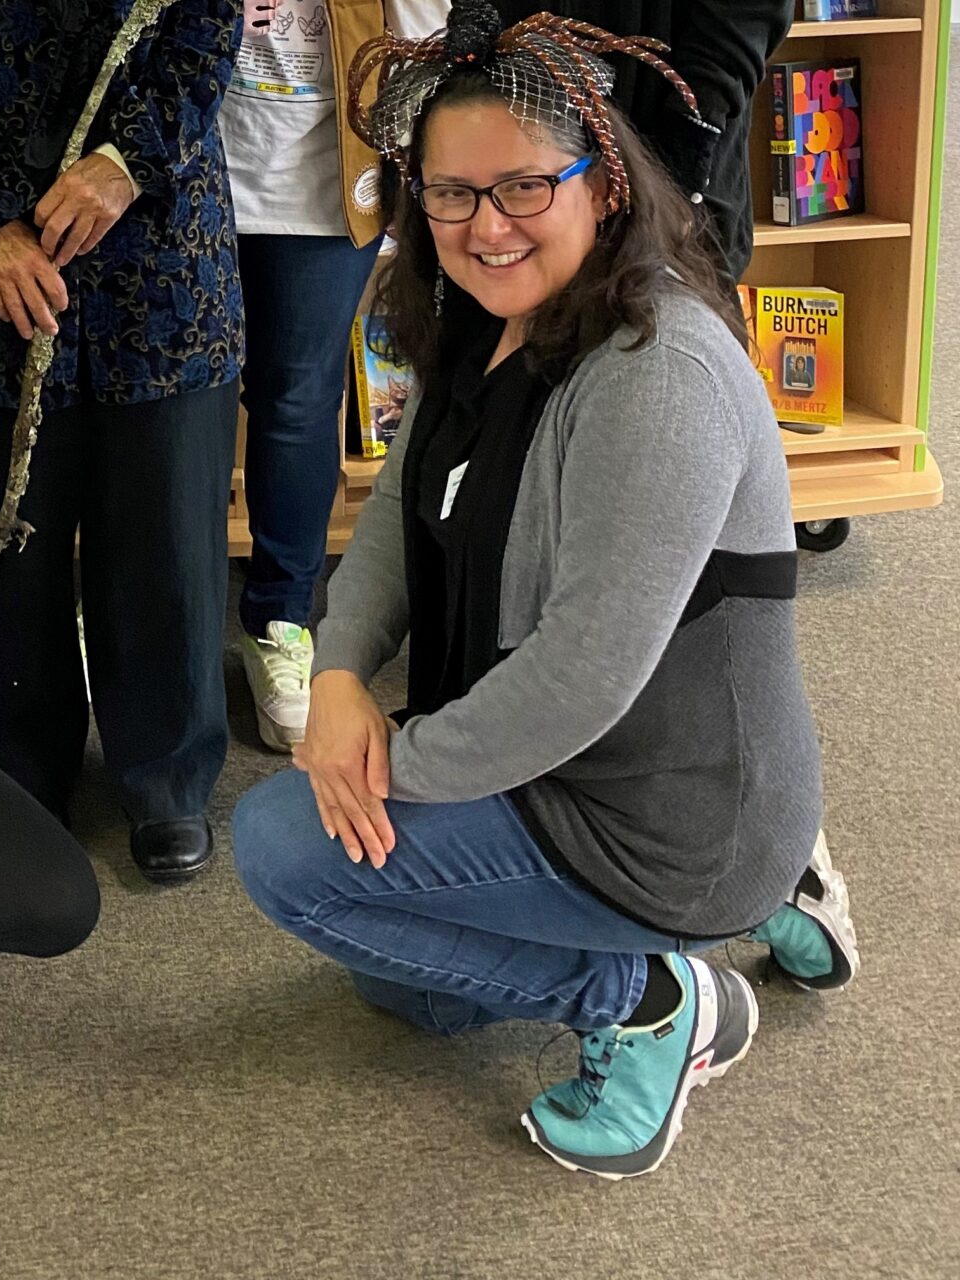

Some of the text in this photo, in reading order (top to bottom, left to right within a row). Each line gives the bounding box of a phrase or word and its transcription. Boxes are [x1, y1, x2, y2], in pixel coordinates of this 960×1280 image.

[793, 69, 858, 115] BLACK
[794, 108, 859, 156] FOOD
[773, 316, 828, 335] BUTCH
[794, 401, 827, 413] MERTZ
